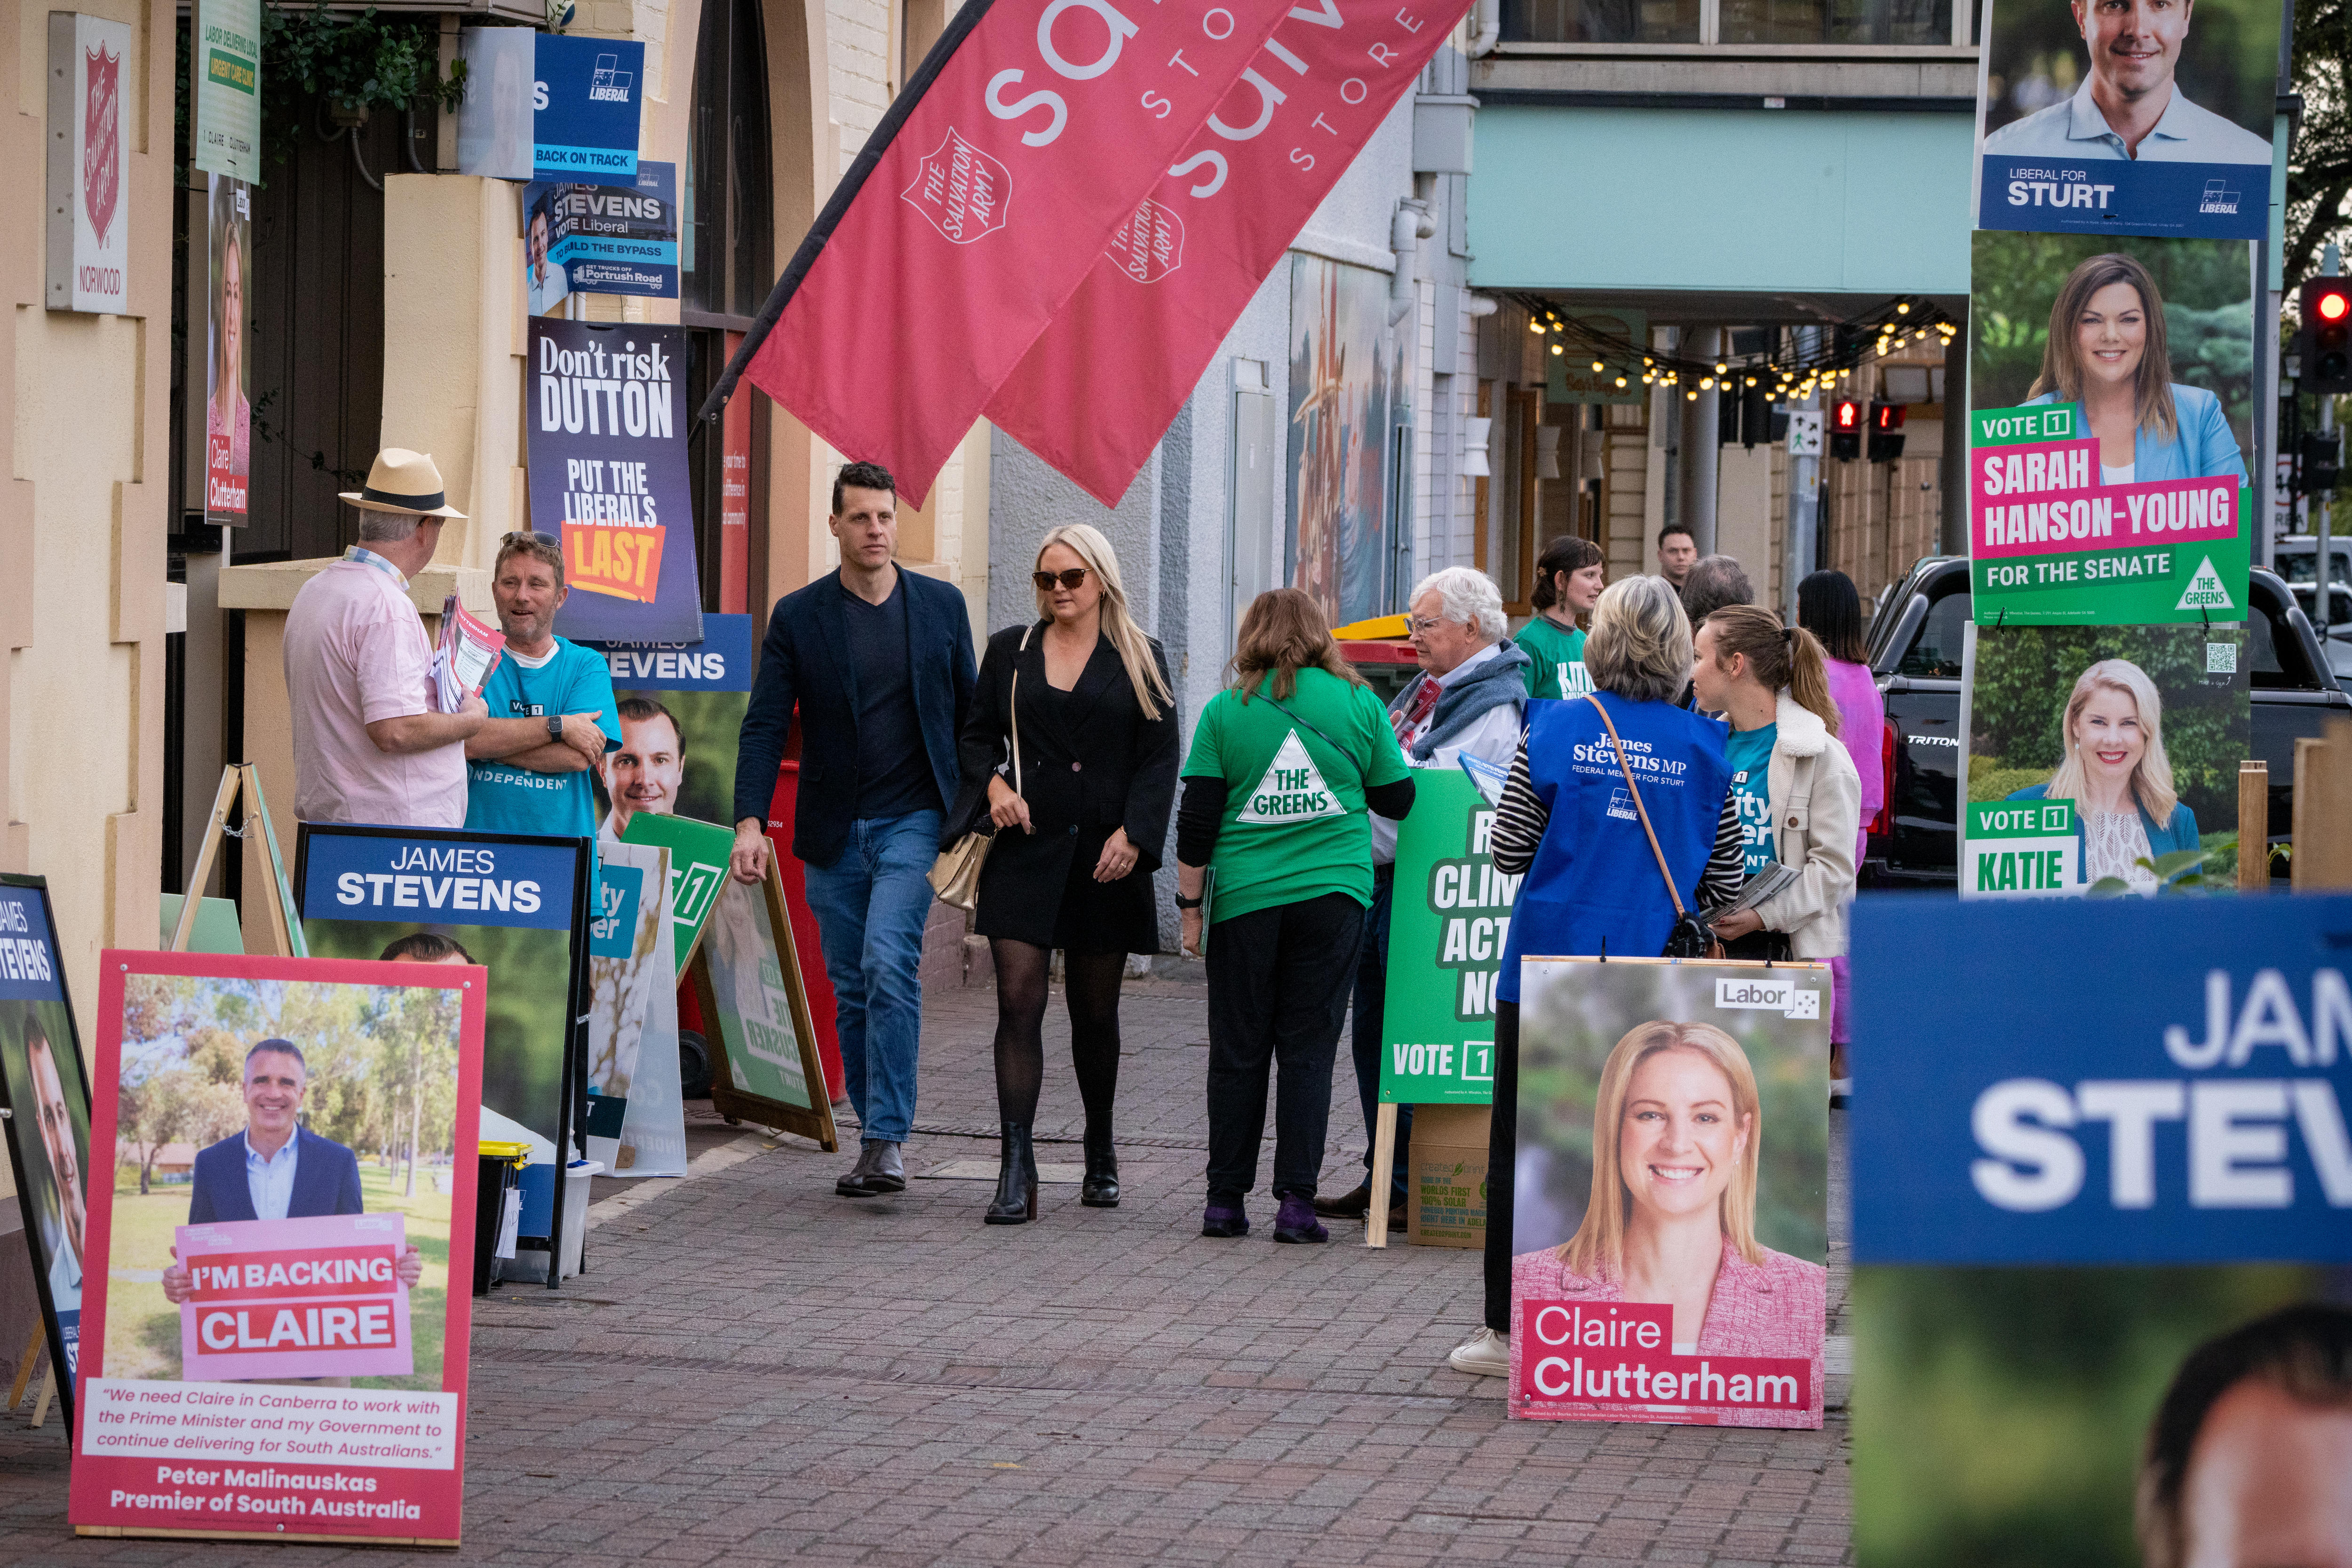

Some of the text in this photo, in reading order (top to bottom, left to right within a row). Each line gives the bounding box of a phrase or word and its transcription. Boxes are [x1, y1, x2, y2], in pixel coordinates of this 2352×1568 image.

[206, 24, 257, 59] LABOR DELIVERING LOCAL
[211, 57, 254, 88] URGENT CARE CLINIC
[91, 66, 105, 123] THE
[589, 87, 629, 102] LIBERAL
[1289, 7, 1424, 171] STORE
[86, 77, 117, 192] SALVATION
[209, 131, 224, 146] CLAIRE
[230, 136, 251, 155] CLUTTERHAM
[536, 150, 628, 167] BACK ON TRACK
[96, 135, 115, 216] ARMY
[924, 162, 945, 206] THE
[943, 139, 972, 239] SALVATION
[2010, 169, 2086, 181] LIBERAL FOR
[238, 192, 246, 208] Labor
[555, 194, 660, 223] STEVENS
[969, 160, 995, 228] ARMY
[2008, 181, 2114, 209] STURT
[2199, 203, 2238, 214] LIBERAL
[556, 217, 628, 239] VOTE Liberal
[1152, 212, 1173, 269] ARMY
[556, 243, 662, 261] TO BUILD THE BYPASS
[79, 265, 120, 295] NORWOOD
[586, 270, 662, 283] Portrush Road
[612, 341, 671, 381] risk
[540, 375, 673, 438] DUTTON
[1982, 415, 2059, 438] VOTE 1
[212, 439, 229, 470] Claire
[567, 459, 648, 494] PUT THE
[1984, 448, 2089, 496] SARAH
[211, 477, 246, 509] Clutterham
[564, 492, 657, 528] LIBERALS
[1985, 487, 2229, 547] HANSON-YOUNG
[573, 530, 655, 588] LAST
[1987, 553, 2170, 587] FOR THE SENATE
[2185, 591, 2224, 605] GREENS
[2196, 577, 2215, 590] THE
[603, 652, 725, 680] EVENS
[1595, 733, 1652, 753] James
[1908, 735, 1959, 747] TRITON
[1573, 744, 1686, 775] Stevens MP
[474, 770, 567, 790] NDEPENDENT
[1275, 768, 1310, 791] THE
[1573, 765, 1685, 787] FEDERAL MEMER FOR STURT
[1253, 791, 1328, 816] GREENS
[1606, 808, 1638, 821] LIBERAL
[1979, 811, 2058, 830] VOTE 1
[391, 846, 495, 874] JAMES
[1977, 850, 2063, 892] KATIE
[336, 872, 540, 913] STEVENS
[683, 875, 707, 914] 1
[0, 901, 27, 932] AMES
[0, 938, 51, 981] TEVENS
[1723, 984, 1787, 1005] Labor
[1393, 1044, 1488, 1075] VOTE 1
[1421, 1185, 1471, 1197] WORLDS FIRST
[1421, 1195, 1441, 1206] 100%
[1444, 1197, 1466, 1207] SOLAR
[1441, 1215, 1456, 1224] HERE
[192, 1258, 393, 1290] I’M BACKING
[201, 1305, 391, 1350] CLAIRE
[1536, 1305, 1661, 1349] Claire
[1534, 1356, 1797, 1404] Clutterham
[140, 1391, 182, 1403] need
[186, 1392, 234, 1405] Claire
[239, 1393, 253, 1406] in
[259, 1395, 336, 1410] Canberra
[342, 1399, 358, 1411] to
[364, 1400, 402, 1413] work
[407, 1401, 440, 1414] with
[99, 1410, 442, 1437] the Prime Minister and my Government to
[97, 1433, 169, 1448] continue
[174, 1436, 254, 1455] delivering
[260, 1439, 282, 1452] for
[287, 1441, 333, 1454] South
[158, 1466, 377, 1493] Peter Malinauskas
[111, 1489, 421, 1520] Premier of South Australia
